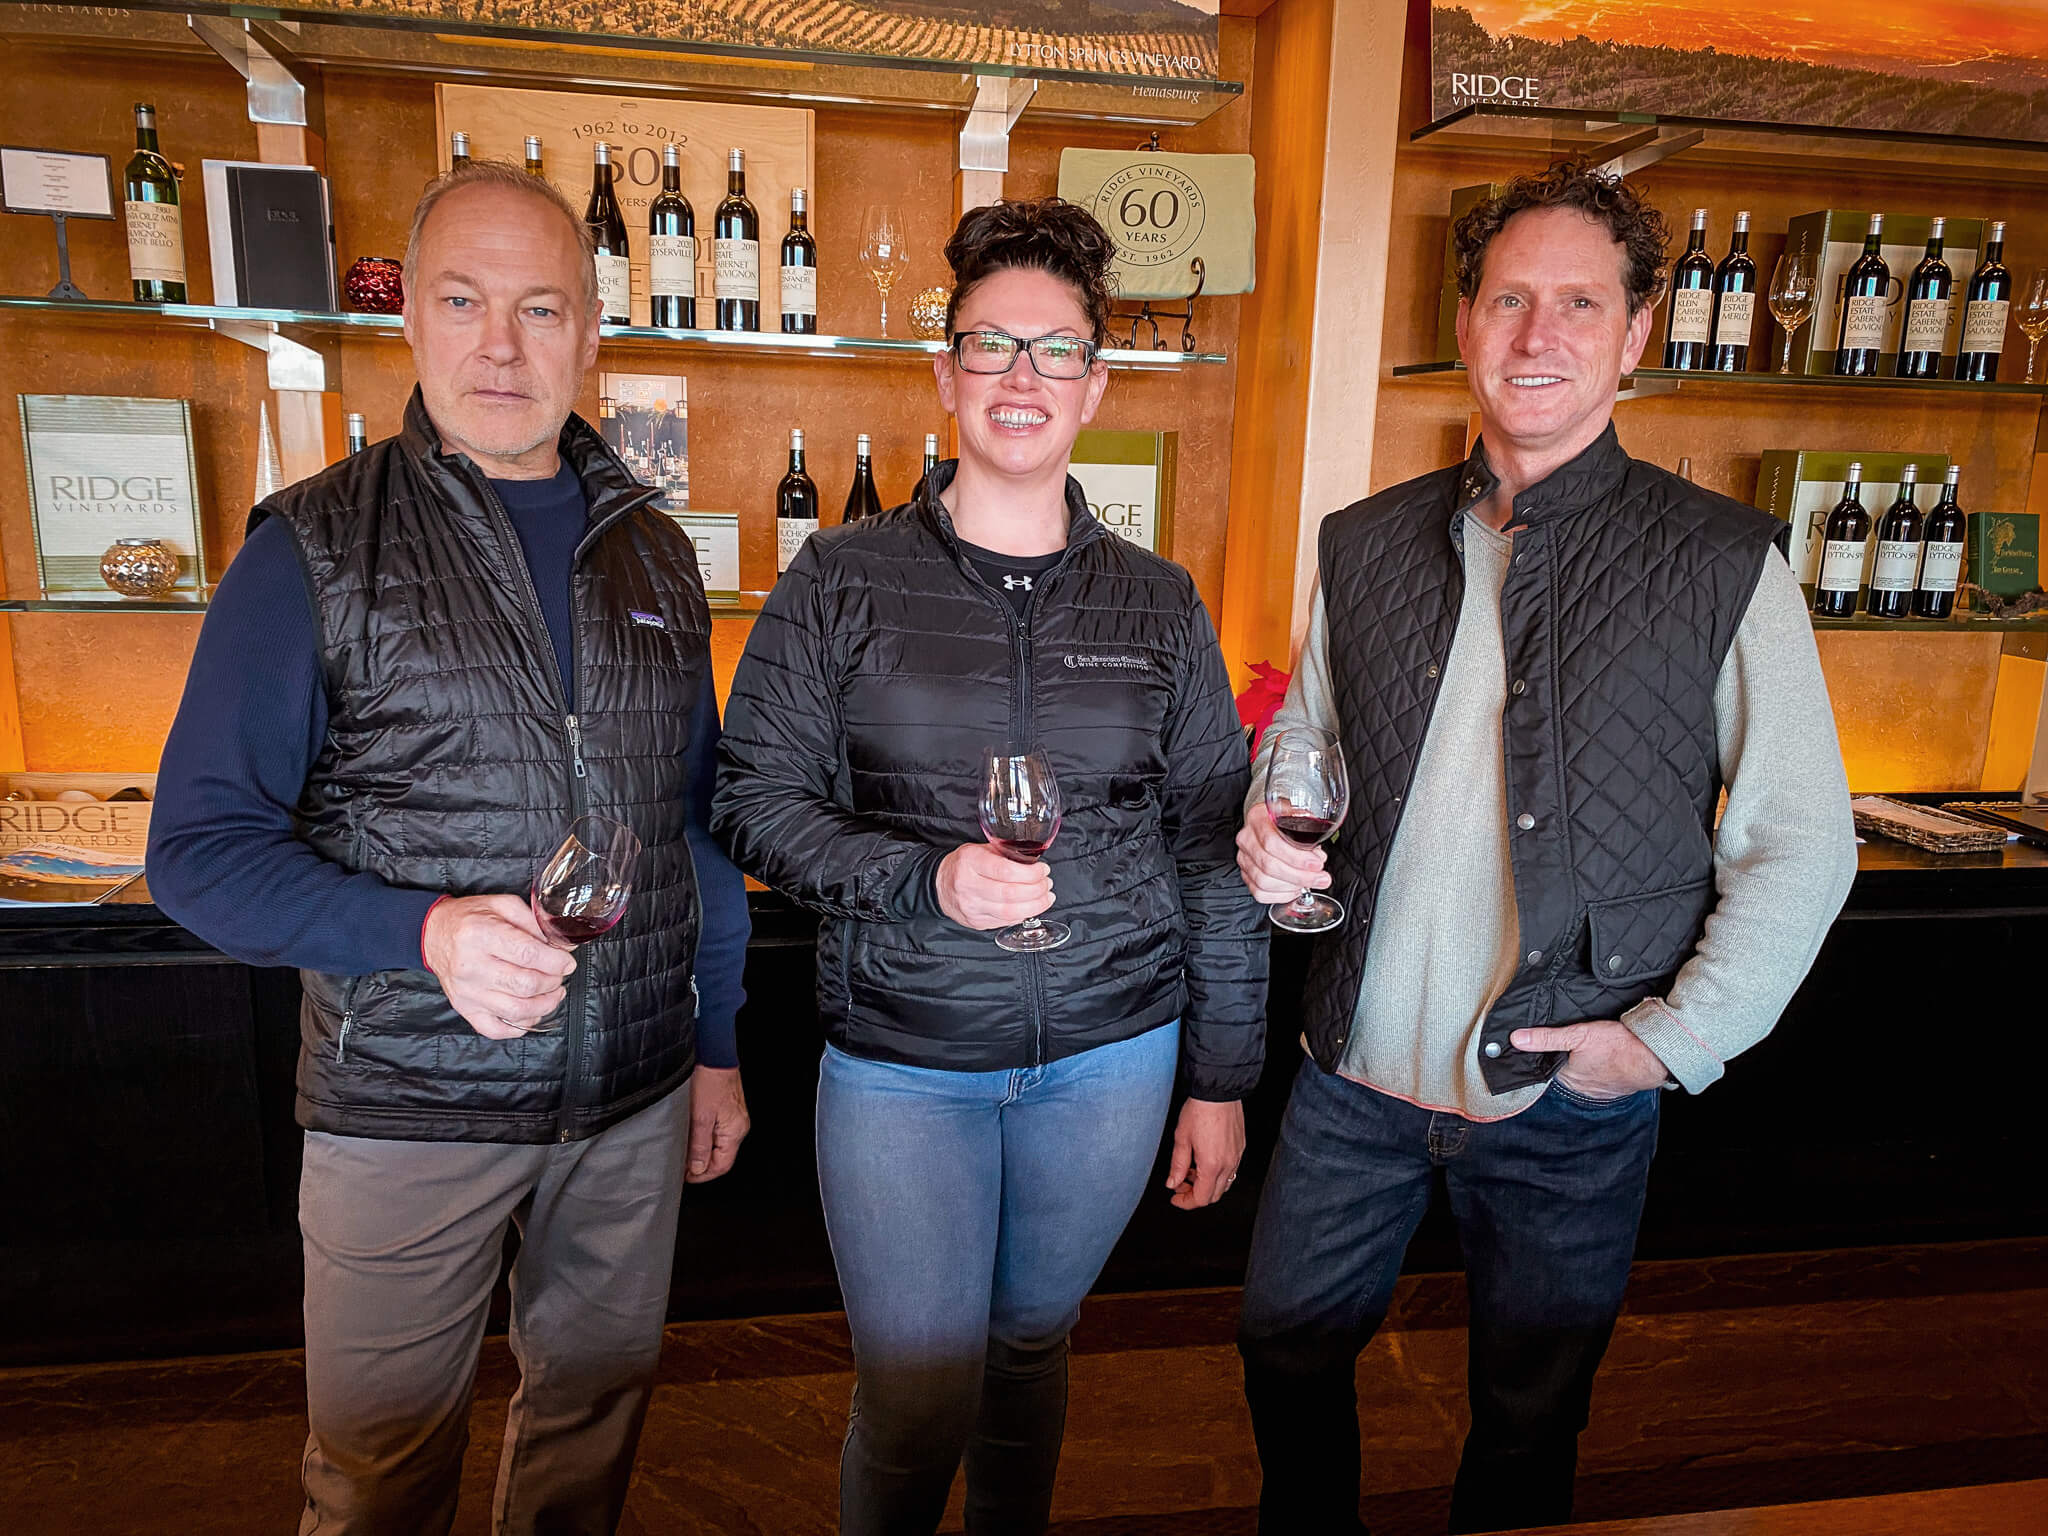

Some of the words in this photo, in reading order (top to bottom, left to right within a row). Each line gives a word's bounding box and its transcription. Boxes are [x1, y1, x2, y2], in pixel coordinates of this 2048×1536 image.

[1010, 43, 1065, 59] LYTTON
[1068, 48, 1128, 65] SPRINGS
[1130, 53, 1201, 70] VINEYARD
[1452, 72, 1540, 99] RIDGE
[572, 121, 615, 140] 1962
[622, 122, 639, 134] to
[645, 124, 688, 148] 2012
[1101, 171, 1133, 203] RIDGE
[1138, 167, 1201, 208] VINEYARDS
[1119, 188, 1179, 229] 60
[1125, 231, 1167, 243] YEARS
[1145, 249, 1174, 263] 1962
[1678, 291, 1701, 299] RIDGE
[1724, 295, 1748, 303] RIDGE
[1851, 299, 1876, 307] RIDGE
[1912, 302, 1936, 310] RIDGE
[1970, 303, 1993, 311] RIDGE
[1850, 307, 1875, 315] ESTATE
[1911, 310, 1937, 318] ESTATE
[1969, 311, 1993, 319] ESTATE
[51, 475, 176, 502] RIDGE
[51, 502, 178, 514] VINEYARDS
[1087, 502, 1142, 526] DGE
[0, 806, 131, 833] RIDGE
[0, 834, 133, 847] VINEYARDS
